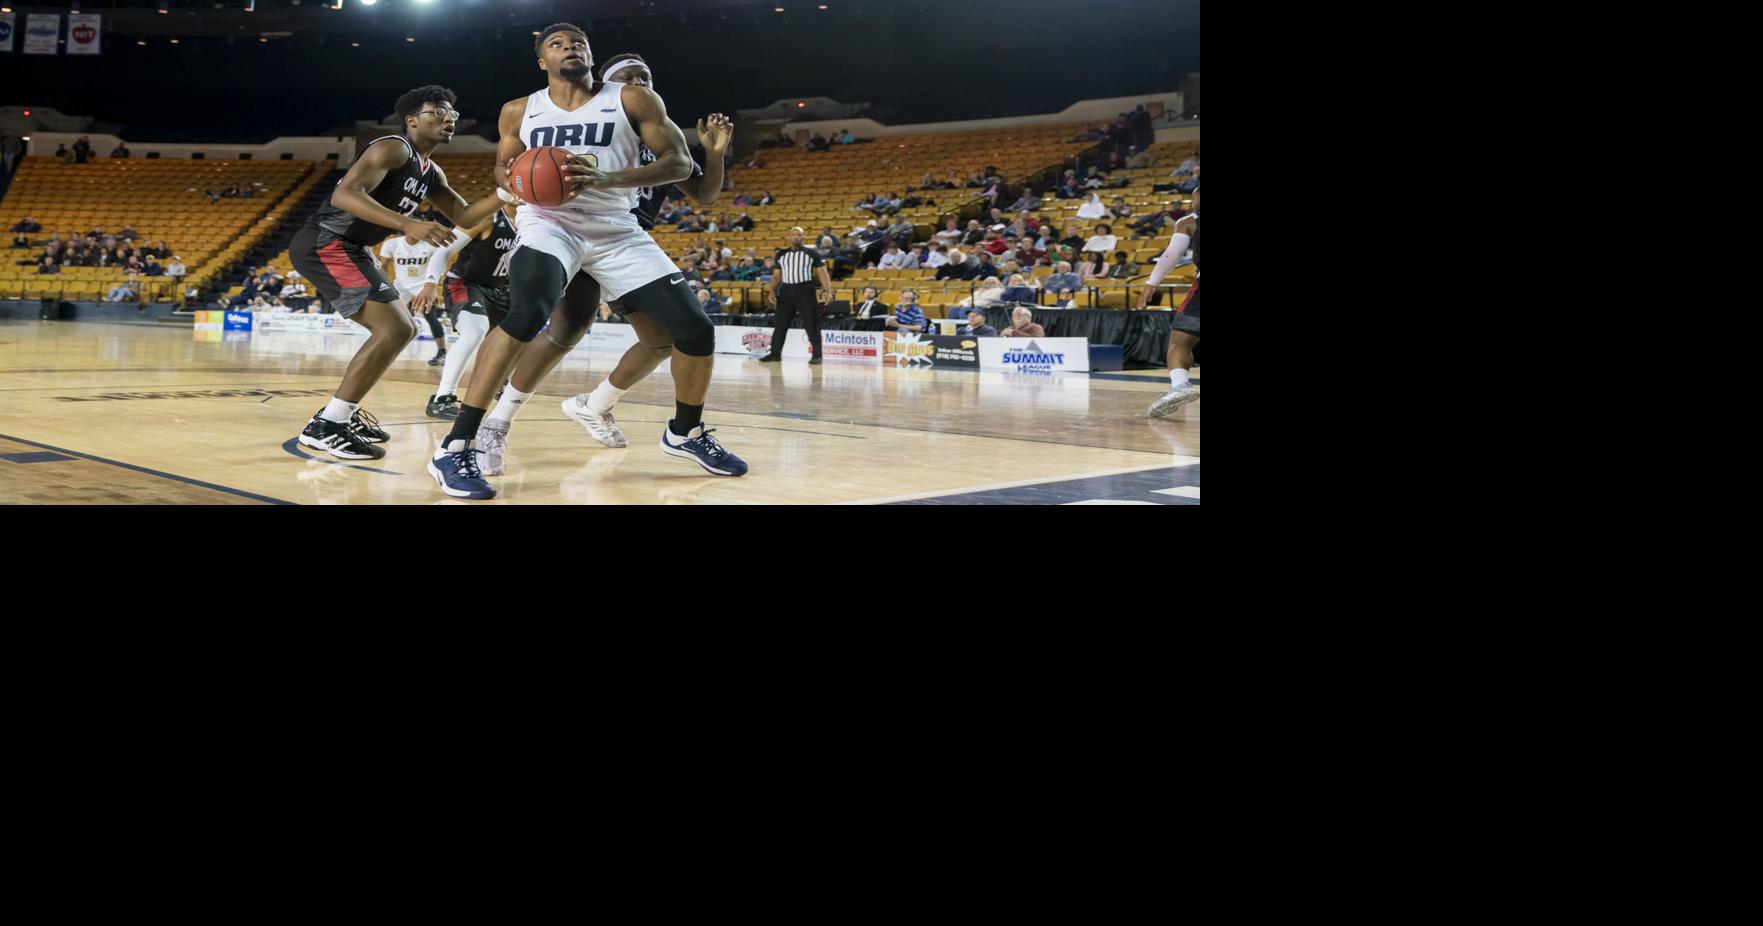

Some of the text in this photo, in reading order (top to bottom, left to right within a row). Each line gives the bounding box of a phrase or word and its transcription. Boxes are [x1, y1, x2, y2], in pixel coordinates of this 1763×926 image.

[74, 30, 95, 39] NIT
[530, 122, 615, 148] ORU
[397, 257, 428, 265] ORU
[825, 333, 877, 345] McIntosh
[1002, 352, 1064, 364] SUMMIT
